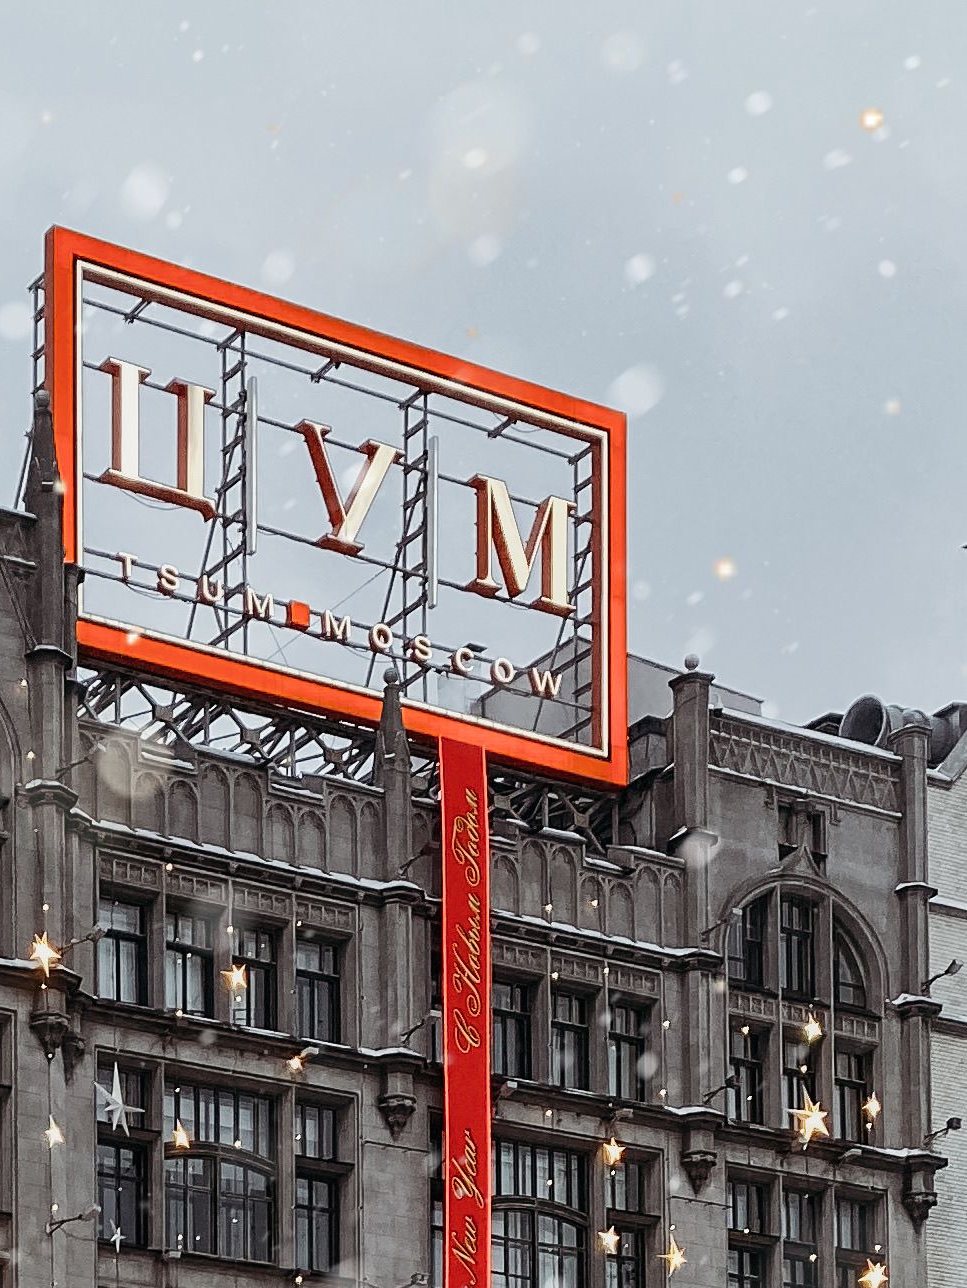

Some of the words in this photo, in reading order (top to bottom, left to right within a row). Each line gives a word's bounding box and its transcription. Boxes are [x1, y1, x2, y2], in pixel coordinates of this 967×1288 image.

[117, 552, 275, 621] TSUM
[321, 609, 565, 697] MOSCOW
[452, 787, 480, 887] Годом
[453, 892, 481, 1018] Новым
[453, 1008, 481, 1054] С
[452, 1129, 484, 1209] Year
[451, 1215, 477, 1286] New
